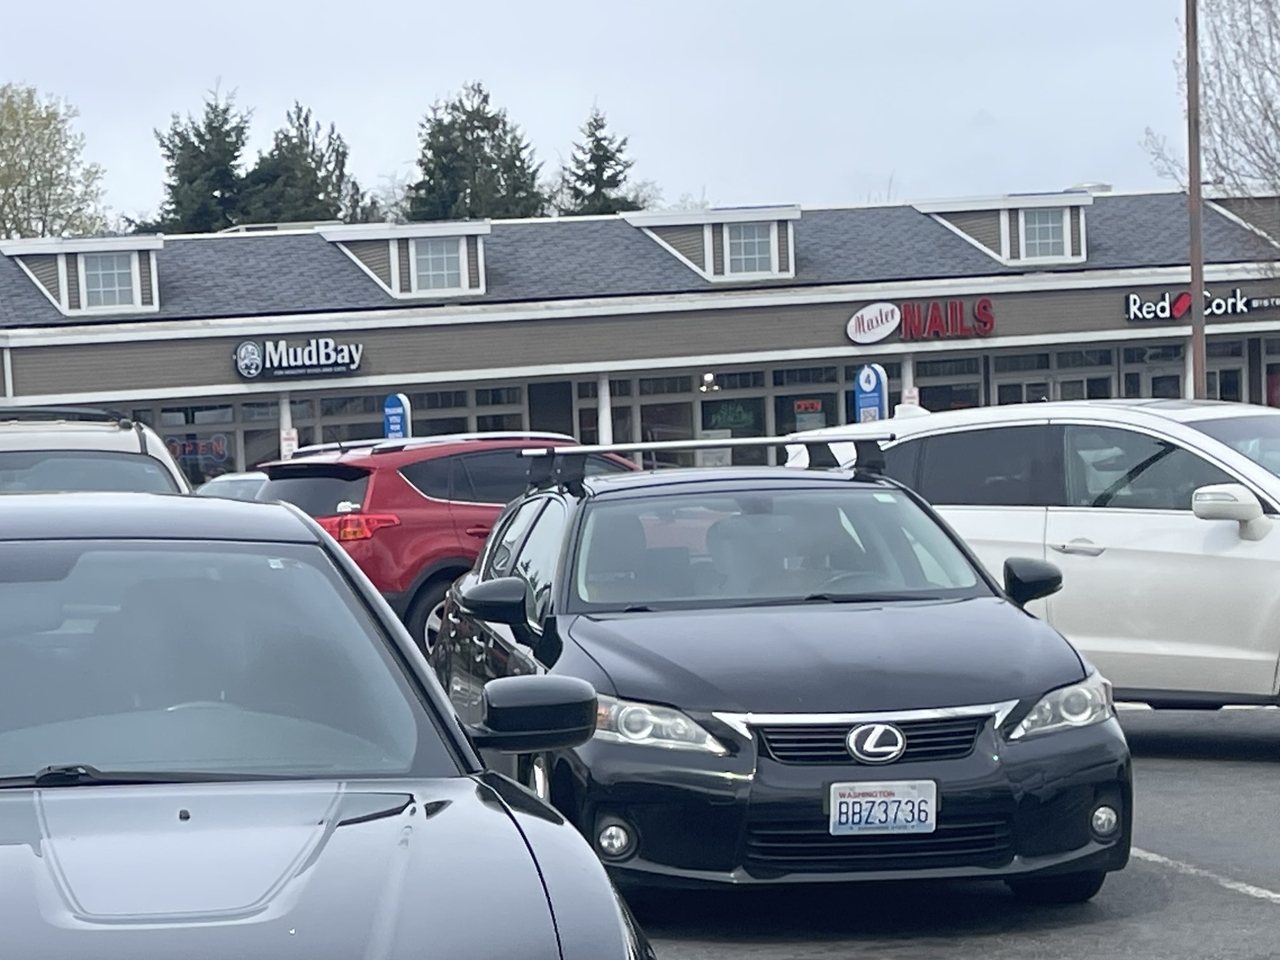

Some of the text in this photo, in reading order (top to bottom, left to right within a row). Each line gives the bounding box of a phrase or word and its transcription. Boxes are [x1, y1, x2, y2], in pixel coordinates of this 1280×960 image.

[854, 298, 995, 339] Master NAILS
[1129, 292, 1170, 320] Red
[265, 338, 363, 370] MudBay
[864, 373, 871, 386] 4
[167, 440, 224, 455] OPEN
[838, 791, 895, 799] WASHINGTON
[838, 799, 928, 825] BBZ3736
